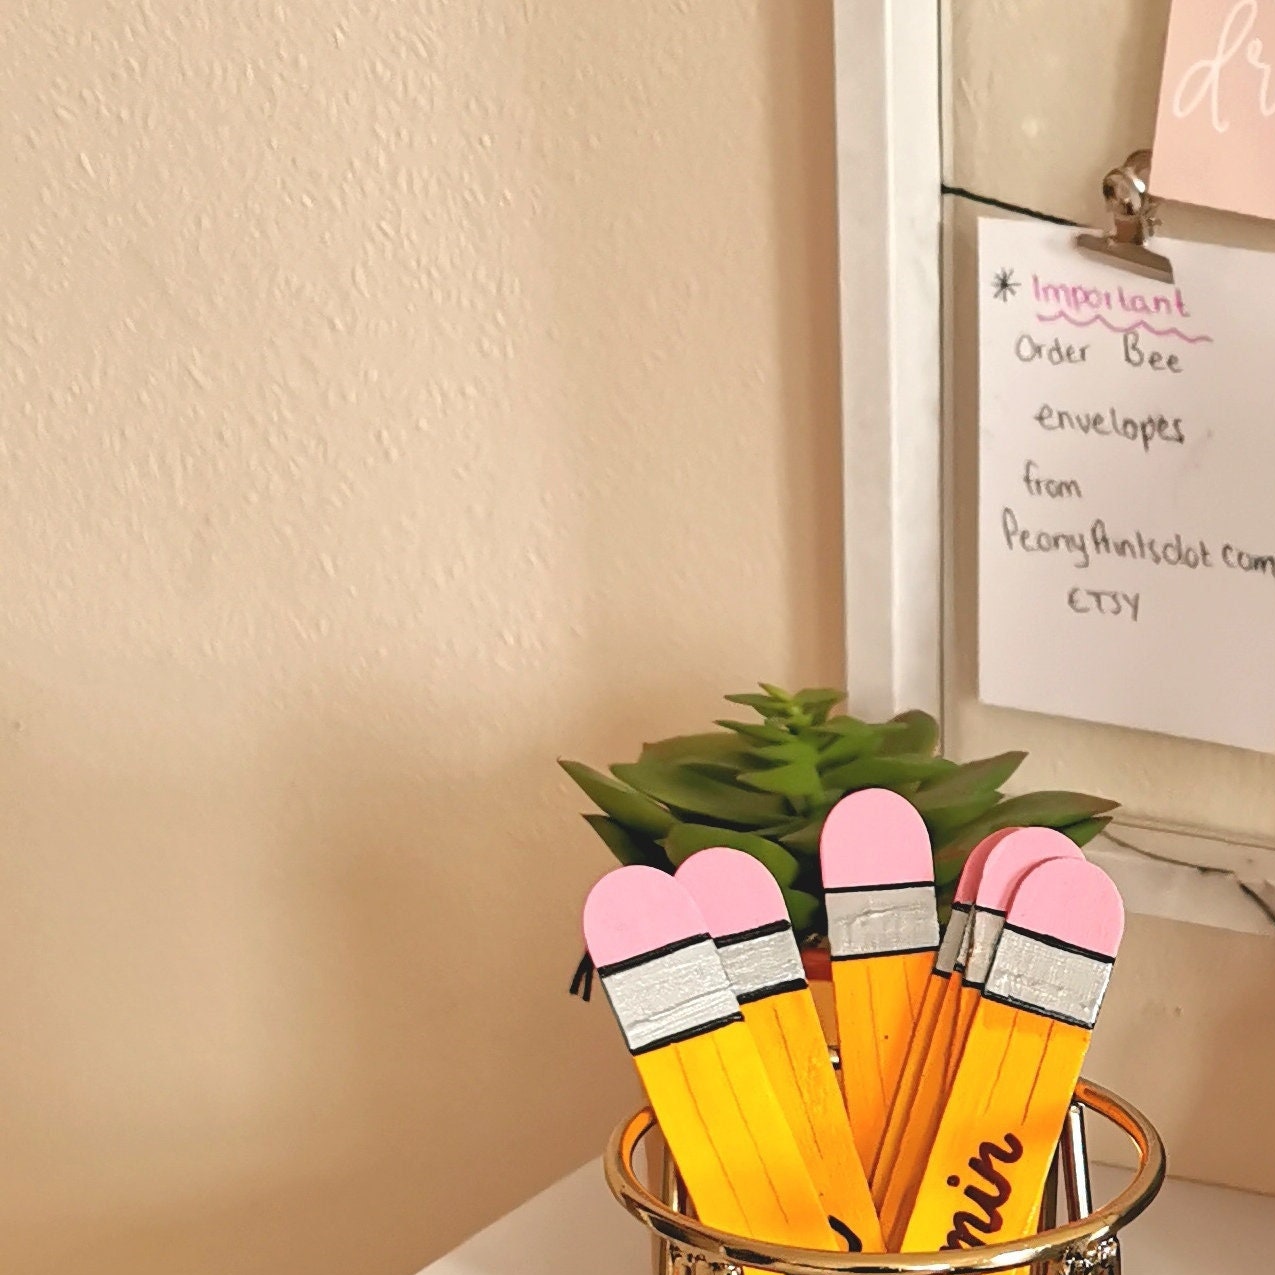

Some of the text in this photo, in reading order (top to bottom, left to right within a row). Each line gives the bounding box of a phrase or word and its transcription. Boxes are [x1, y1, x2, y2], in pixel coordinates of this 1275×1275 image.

[1031, 273, 1191, 317] Important
[1014, 331, 1184, 374] Order Bee
[1033, 403, 1185, 453] envelopes
[1022, 458, 1084, 499] from
[1067, 585, 1141, 623] ETSY
